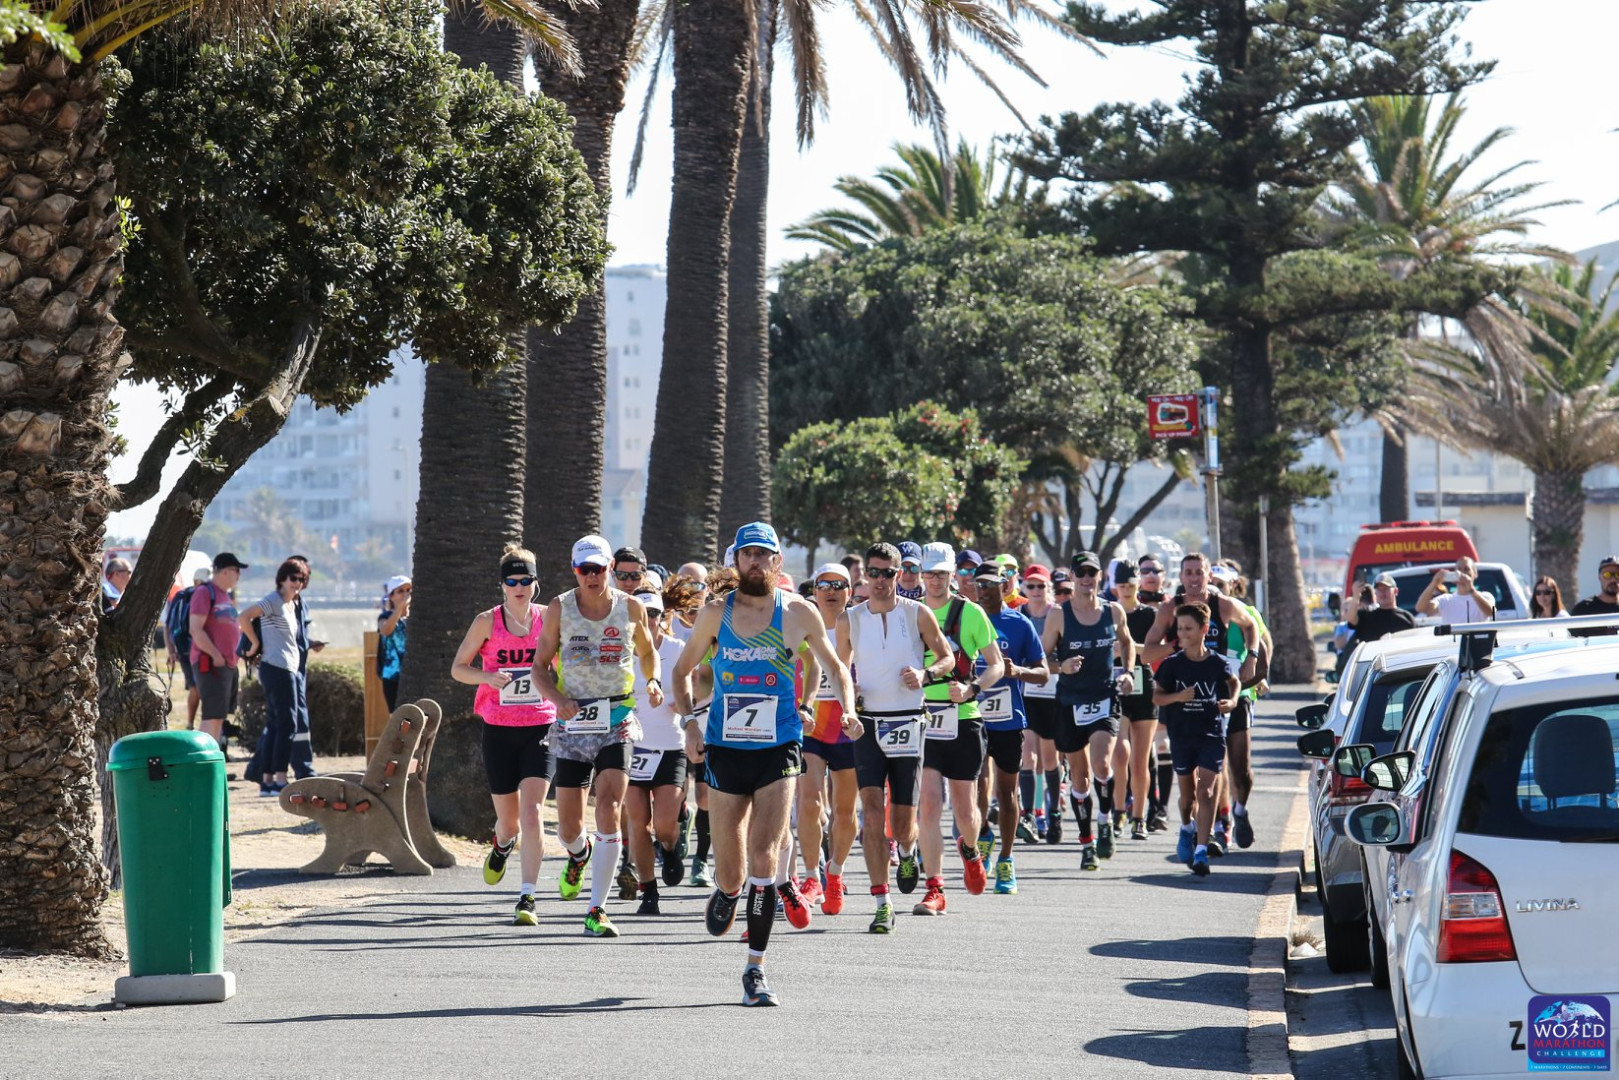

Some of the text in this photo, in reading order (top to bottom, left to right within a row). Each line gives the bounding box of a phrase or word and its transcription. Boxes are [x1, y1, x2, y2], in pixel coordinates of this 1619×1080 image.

[1375, 541, 1454, 554] AMBULANCE
[722, 647, 761, 662] HOKA
[514, 680, 531, 695] 13
[985, 699, 1001, 711] 31
[1083, 702, 1101, 714] 35
[576, 706, 599, 721] 38
[744, 709, 758, 727] 7
[930, 715, 943, 728] 11
[887, 730, 910, 745] 39
[631, 756, 648, 770] 21
[1516, 898, 1580, 913] LIVINA
